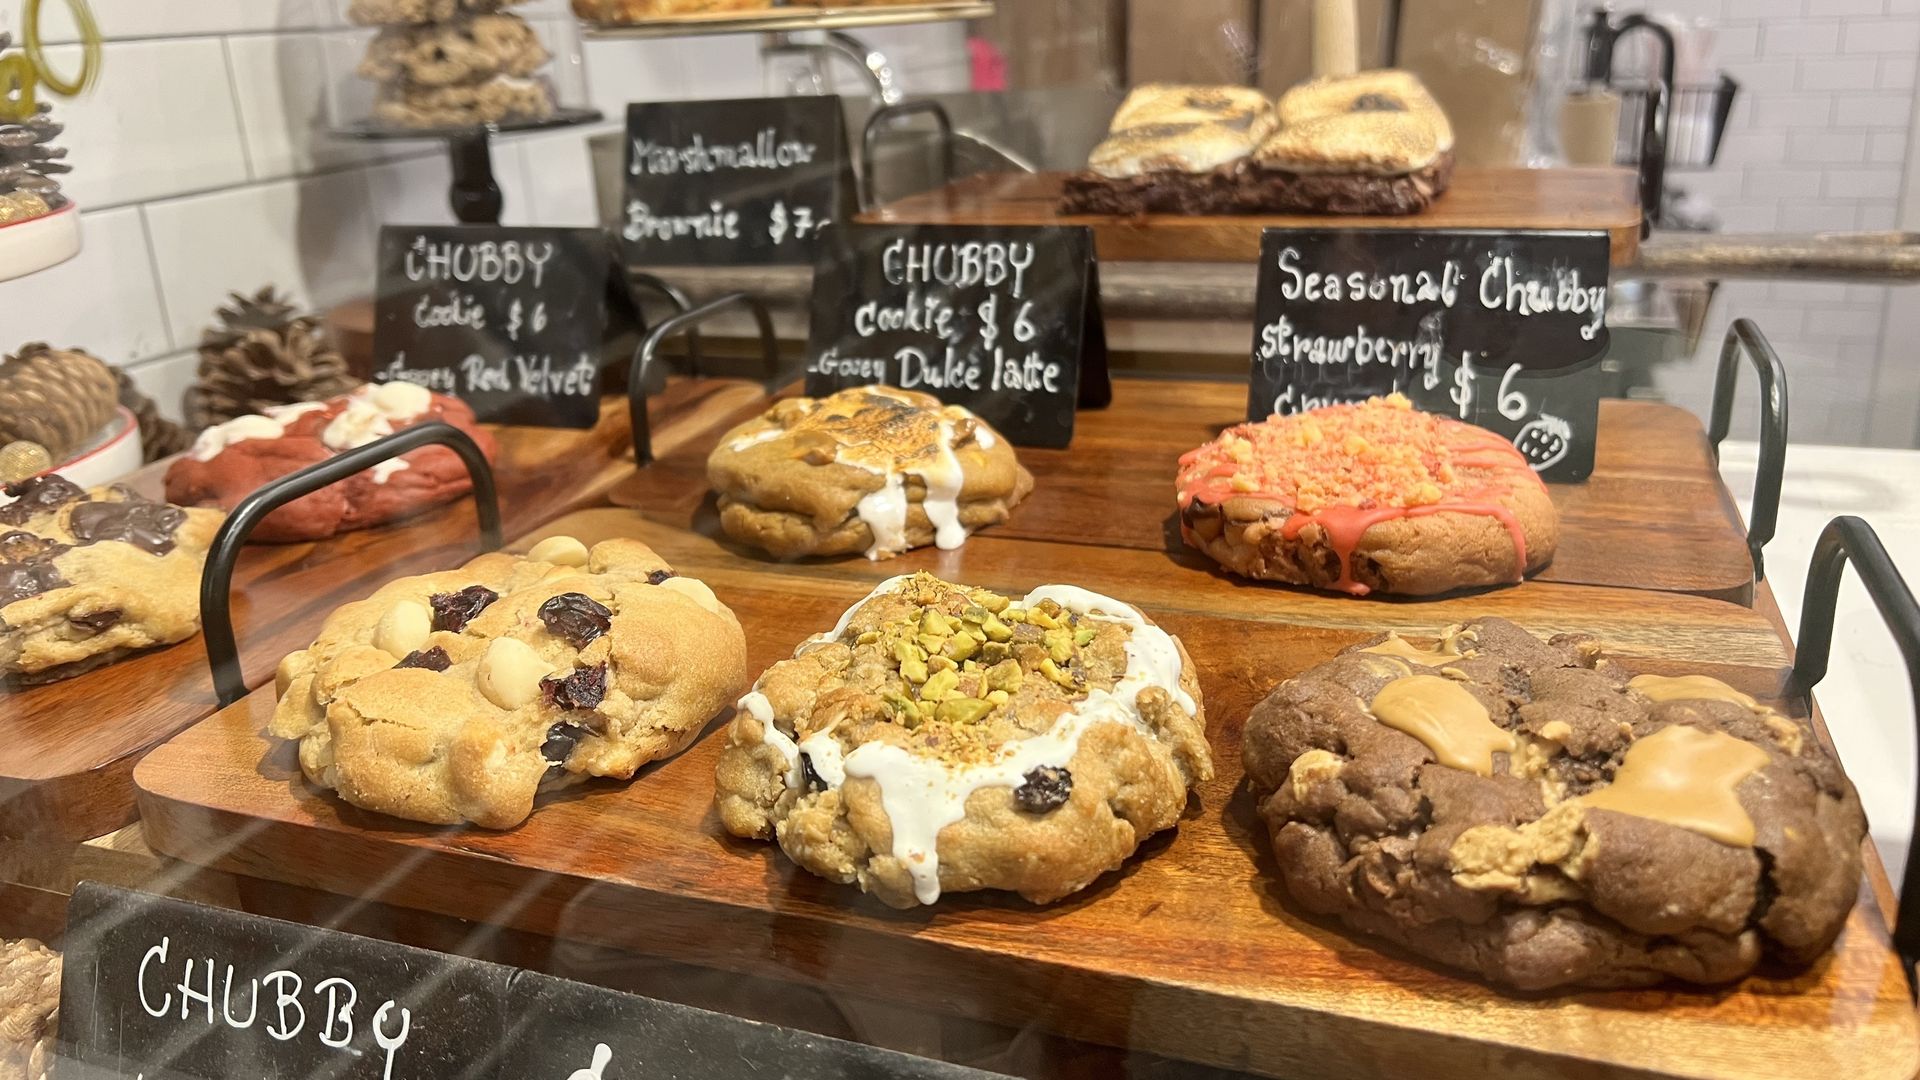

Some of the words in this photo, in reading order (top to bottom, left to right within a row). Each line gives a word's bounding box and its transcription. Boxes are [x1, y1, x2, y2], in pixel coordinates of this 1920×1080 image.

[630, 127, 817, 175] Marshmallow
[623, 200, 740, 241] Brownie
[404, 235, 553, 288] CHUBBY
[882, 238, 1035, 298] CHUBBY
[1277, 246, 1461, 307] Seasonal
[1479, 250, 1607, 341] Chubby
[461, 353, 512, 392] Red
[515, 353, 597, 398] Velvet
[137, 936, 410, 1080] CHUBBY
